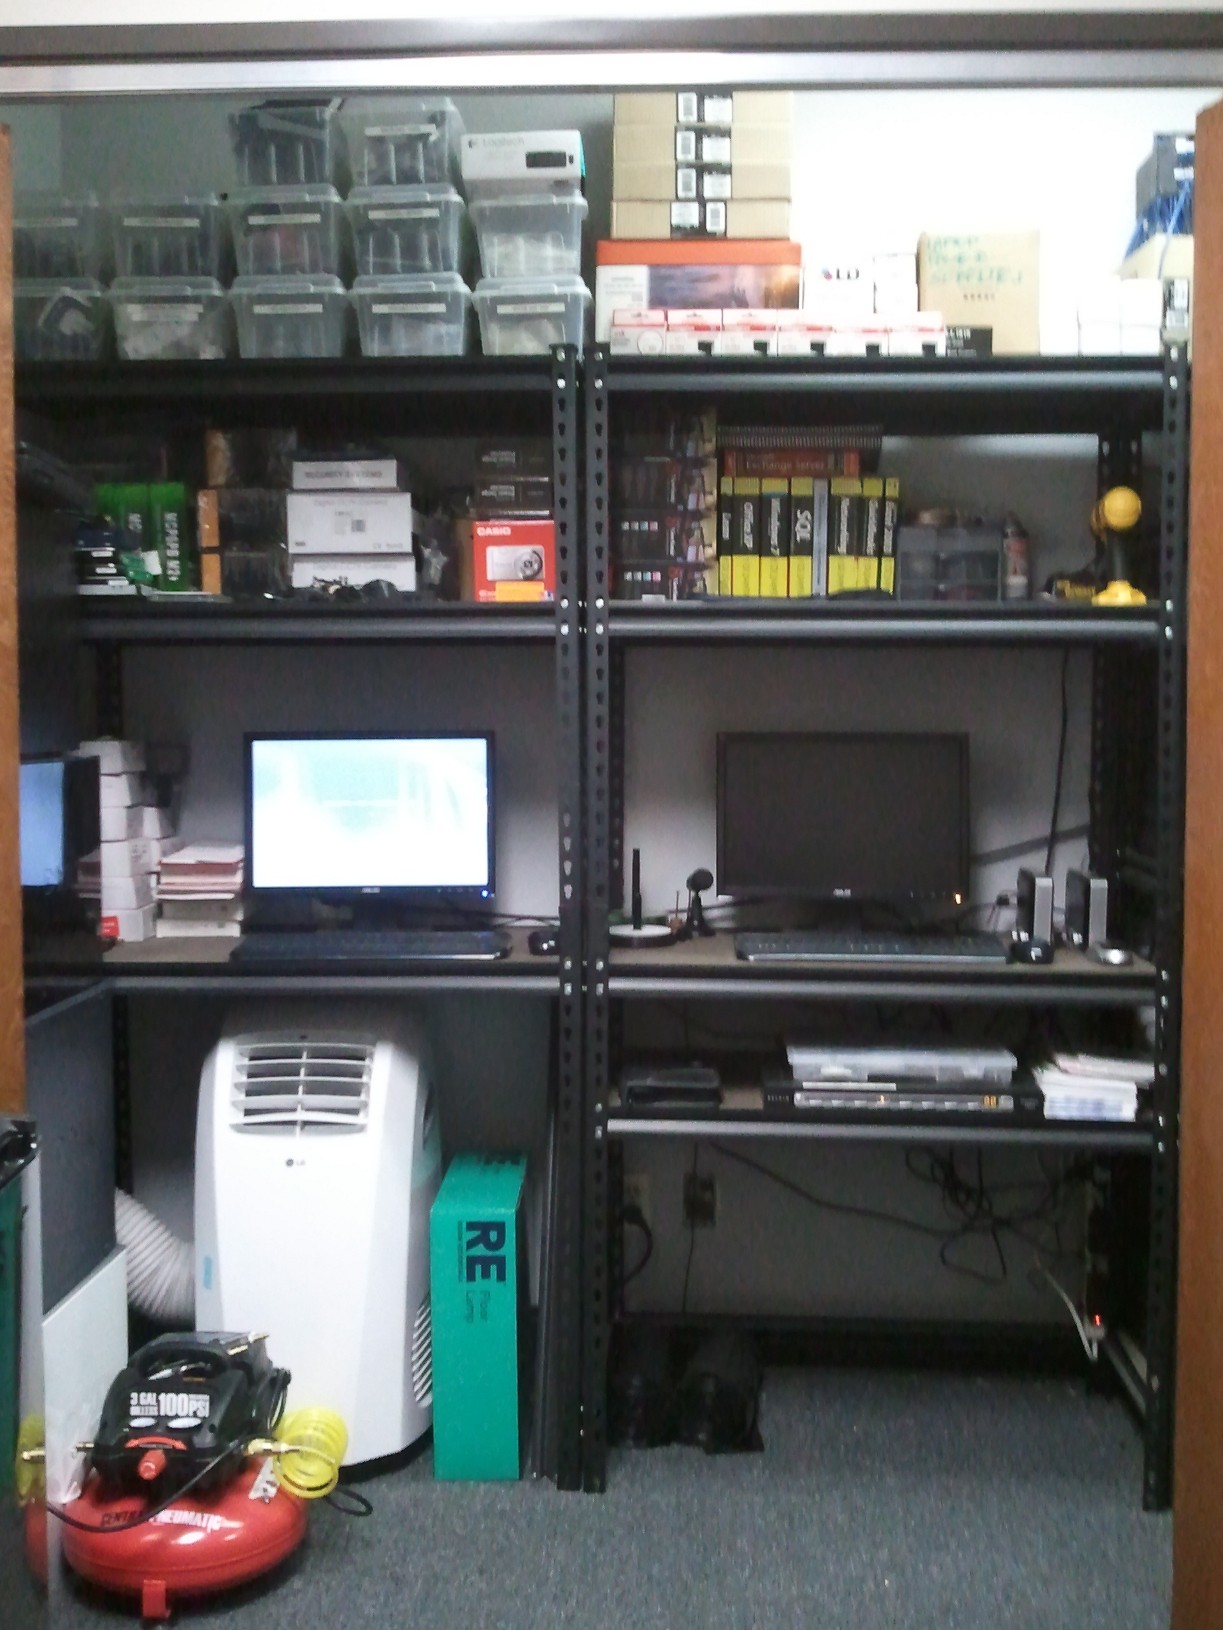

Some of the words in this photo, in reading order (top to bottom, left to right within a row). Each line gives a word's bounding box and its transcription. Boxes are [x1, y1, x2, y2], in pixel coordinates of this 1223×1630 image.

[476, 526, 512, 537] CASIO
[795, 508, 813, 544] SQL
[466, 1221, 507, 1283] RE
[130, 1392, 138, 1405] 3
[139, 1392, 158, 1406] GAL
[158, 1392, 189, 1416] 100
[188, 1399, 210, 1418] PSI
